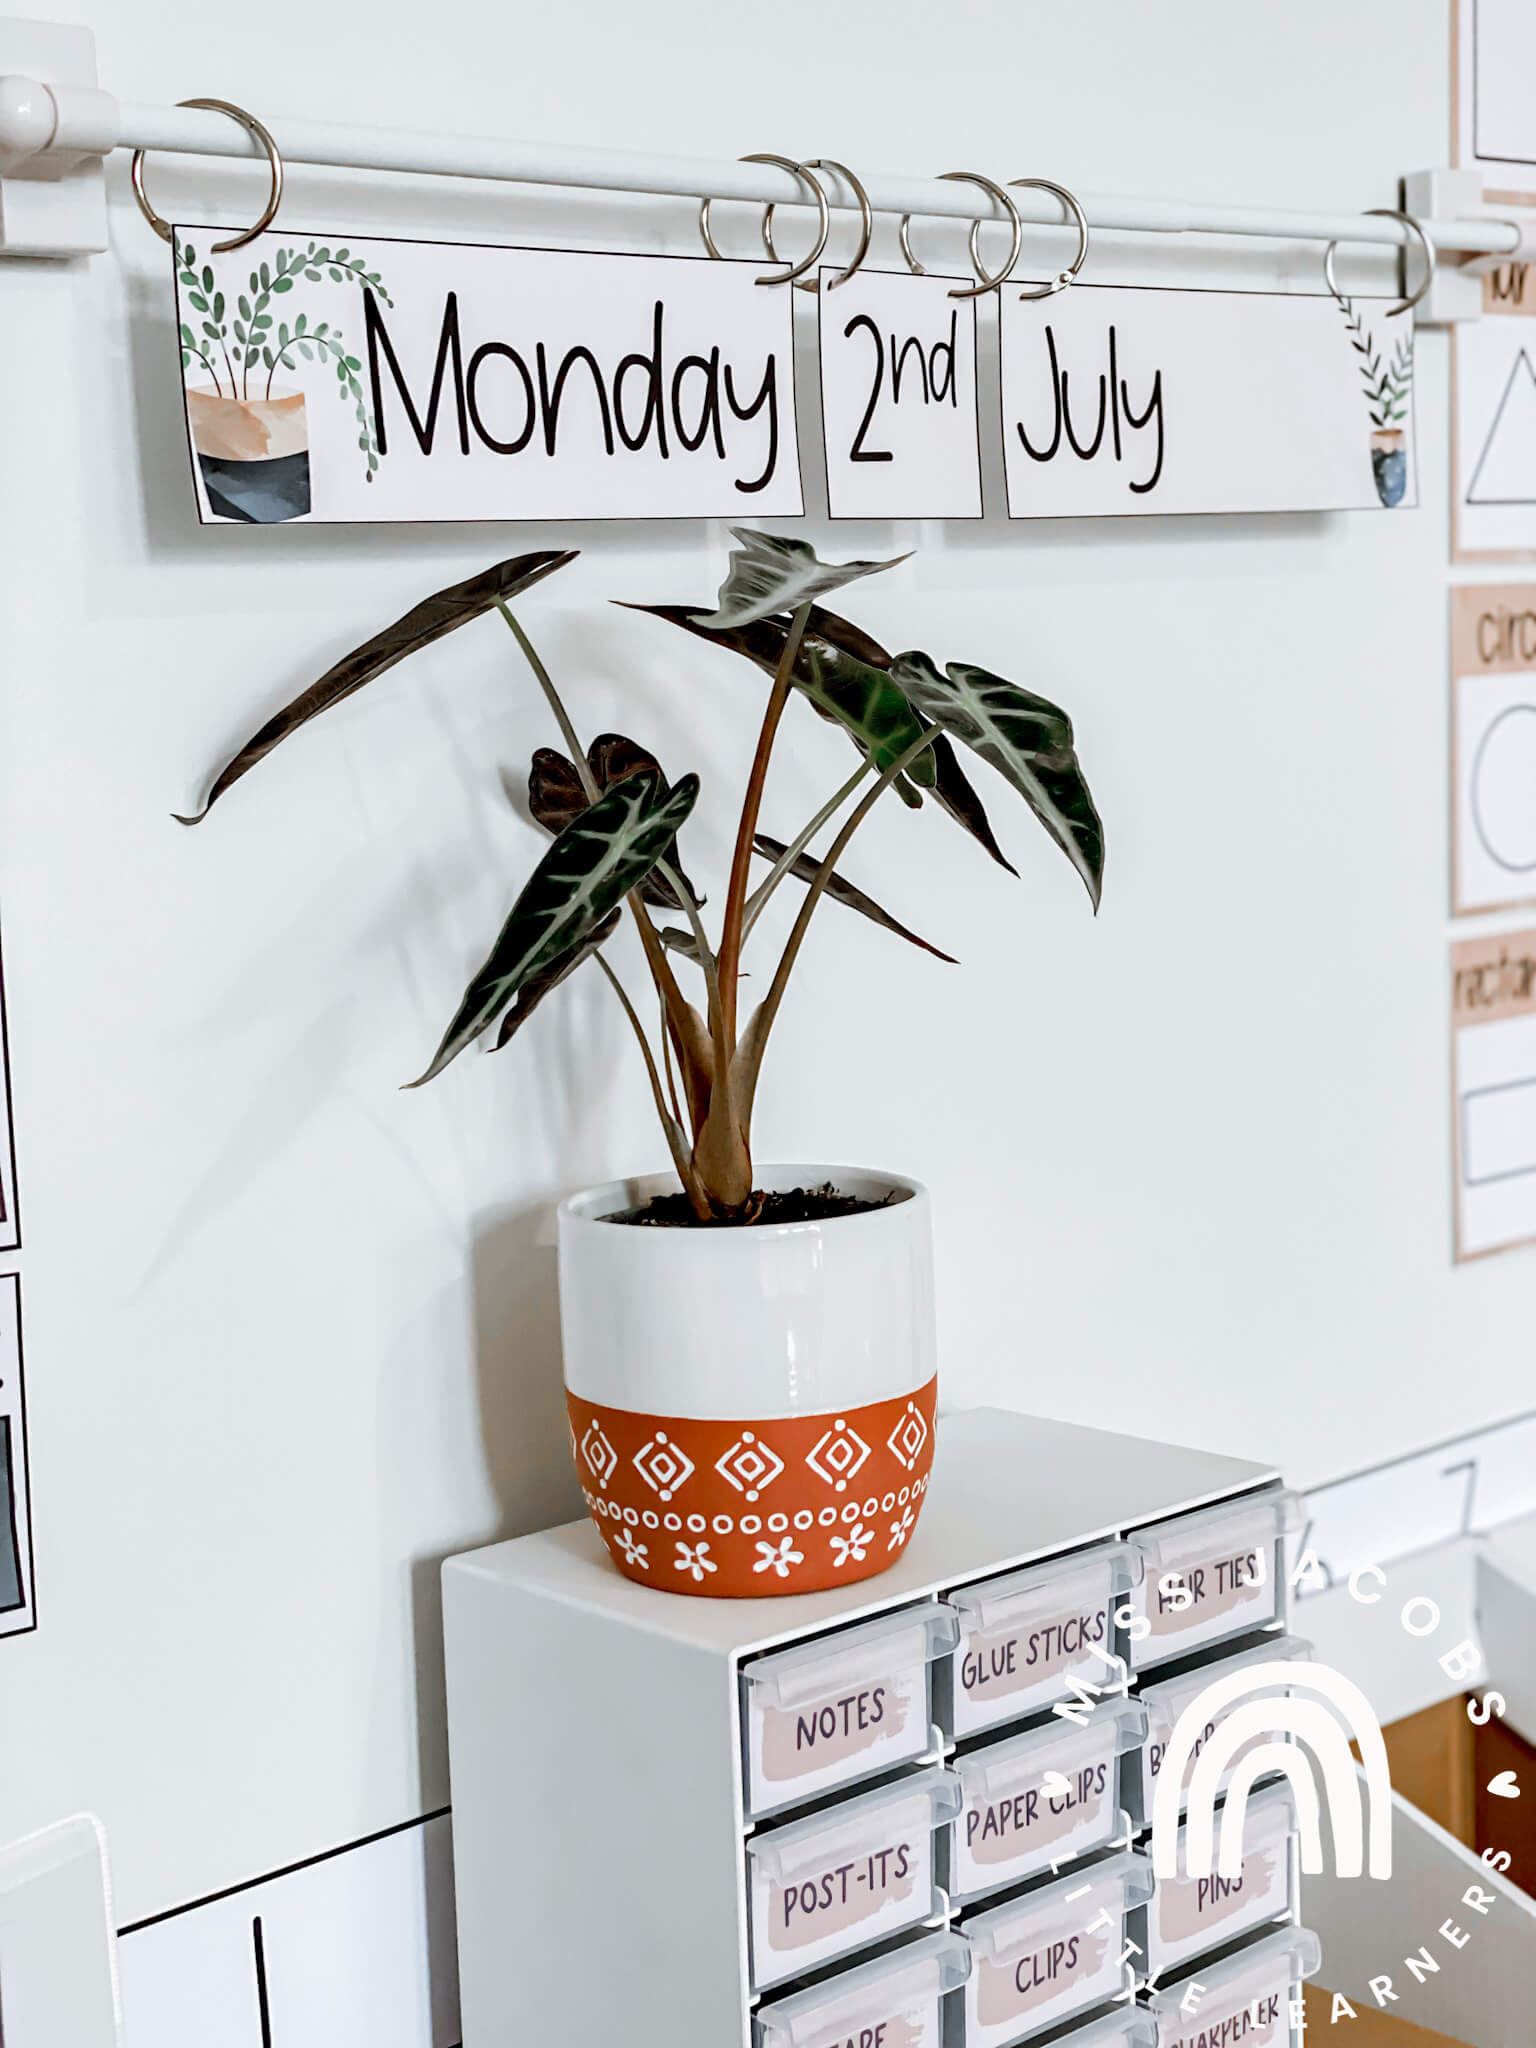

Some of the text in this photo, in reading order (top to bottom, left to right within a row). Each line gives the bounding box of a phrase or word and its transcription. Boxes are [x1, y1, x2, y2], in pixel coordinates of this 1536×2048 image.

[363, 286, 1165, 494] Monday 2nd July
[961, 1610, 1106, 1690] GLUE STICKS
[796, 1687, 886, 1751] NOTES
[967, 1788, 1039, 1847] PAPER
[783, 1843, 911, 1928] POST-ITS
[1014, 1935, 1081, 1994] CLIPS
